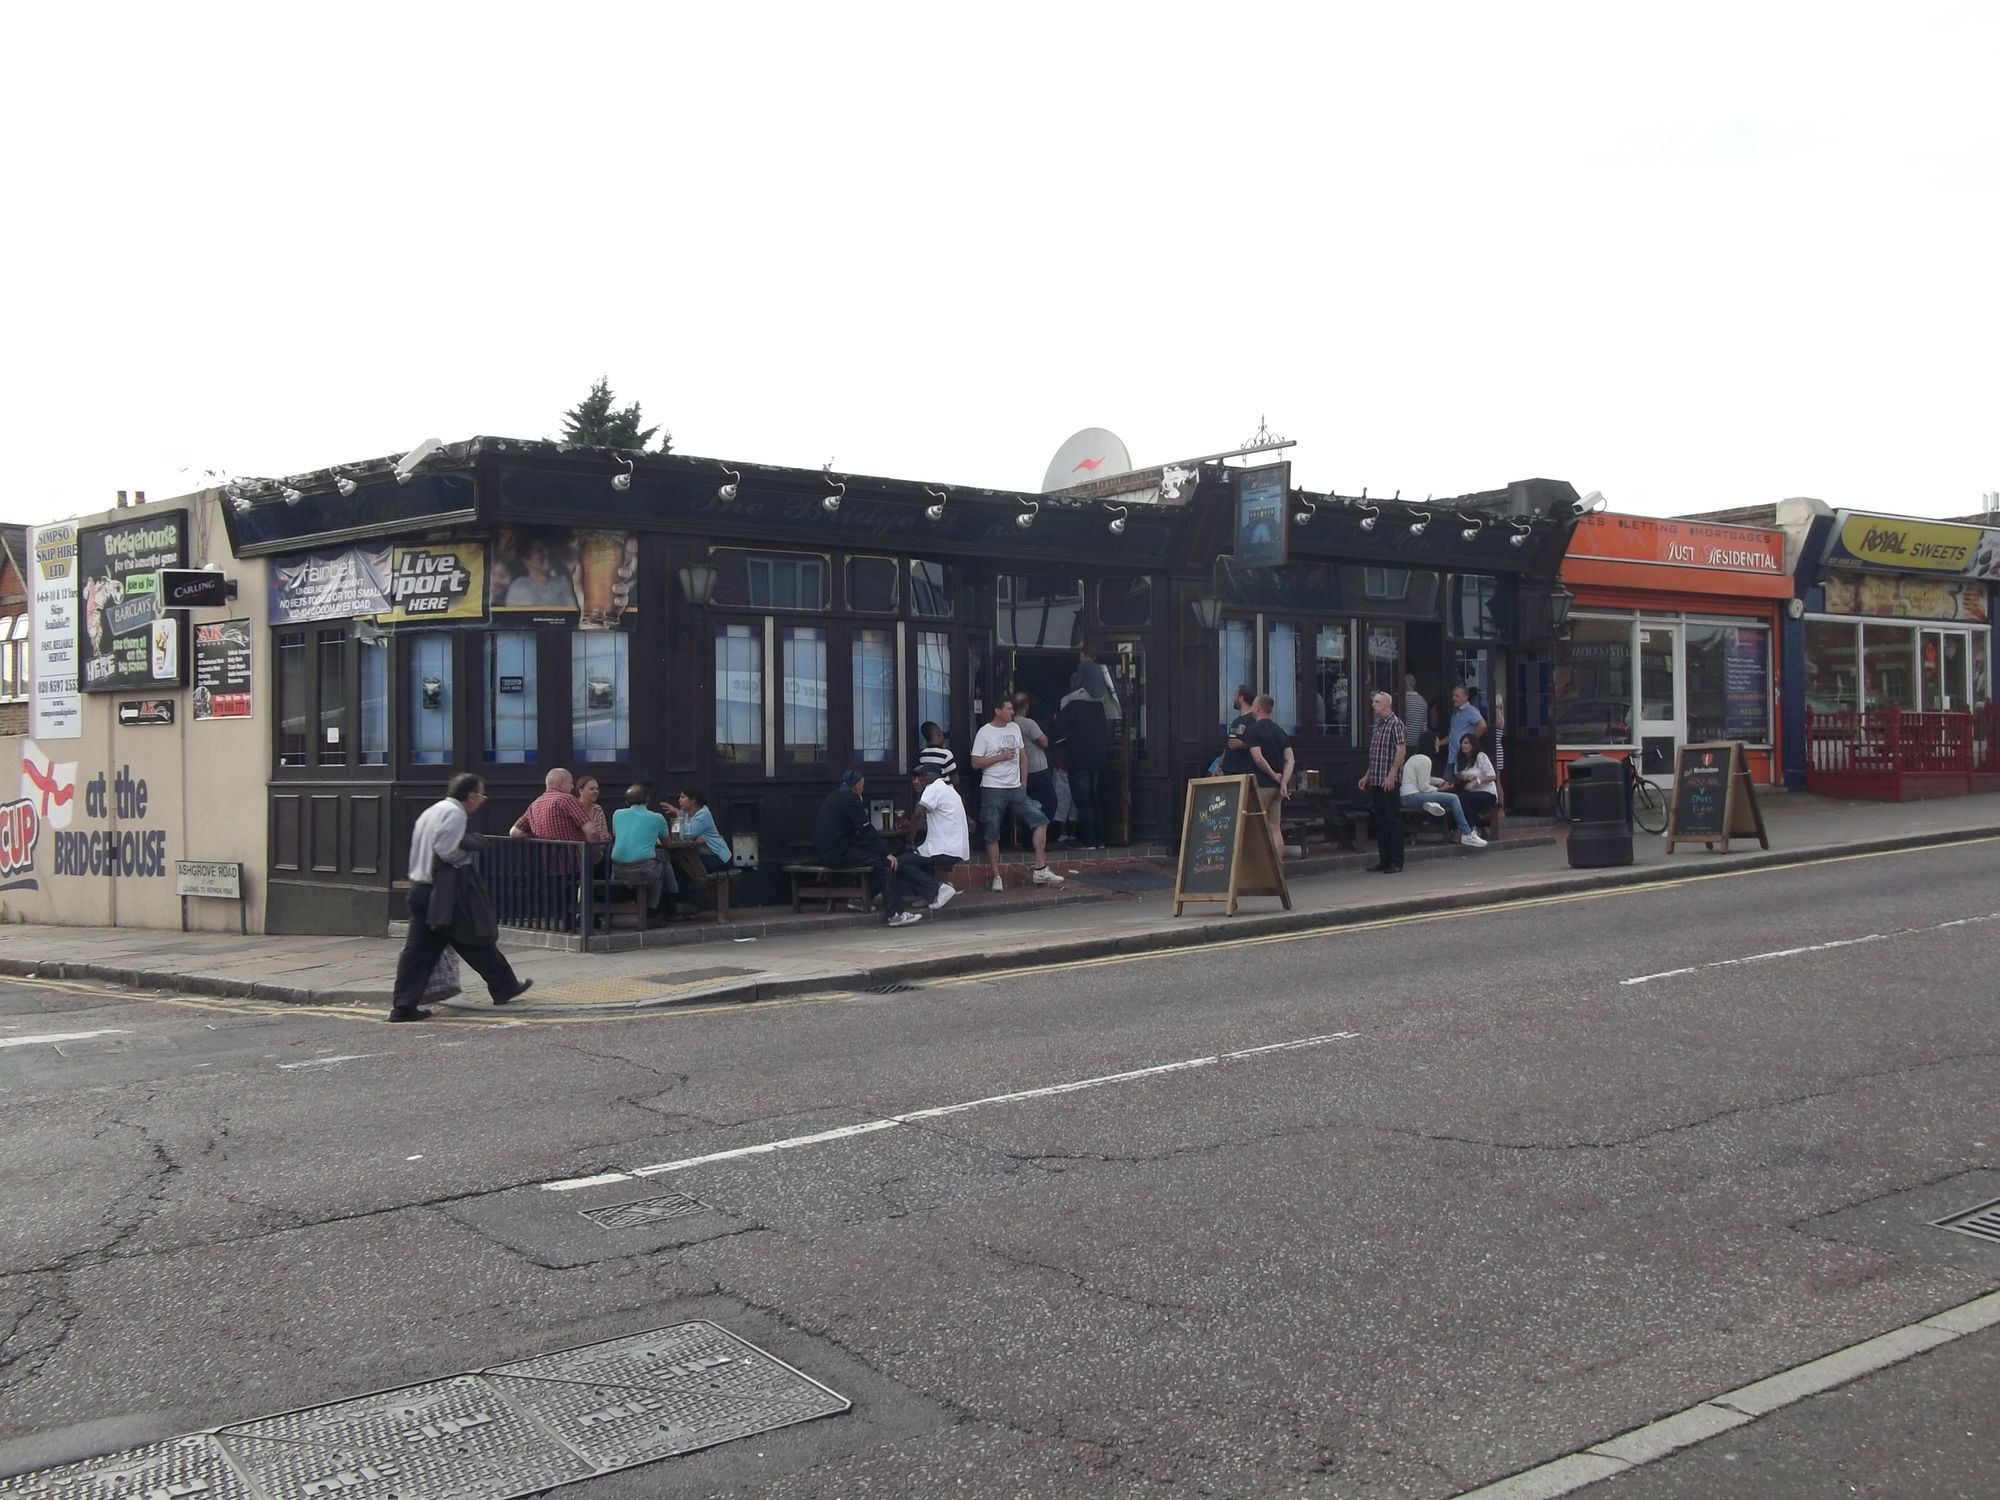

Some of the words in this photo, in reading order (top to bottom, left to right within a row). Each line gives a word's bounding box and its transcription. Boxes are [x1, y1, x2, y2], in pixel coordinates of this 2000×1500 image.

[38, 526, 76, 545] SIMPSON
[104, 525, 177, 557] Bridgehouse
[1623, 520, 1679, 534] LETTING
[1695, 528, 1772, 544] MORTGAGES
[36, 547, 56, 563] SKIP
[57, 543, 78, 560] HIRE
[1666, 541, 1696, 562] JUST
[1704, 544, 1777, 569] RESIDENTIAL
[1860, 527, 1908, 554] ROYAL
[1910, 543, 1967, 561] SWEETS
[49, 564, 65, 578] LTD
[401, 553, 455, 575] Live
[174, 580, 215, 598] CARLING
[357, 588, 382, 598] SMALL
[392, 571, 465, 602] port
[114, 598, 151, 622] BARCLAYS
[408, 597, 448, 612] HERE
[196, 623, 225, 643] AK
[86, 654, 115, 681] HERE
[38, 681, 48, 694] 020
[140, 700, 157, 714] AK
[86, 771, 107, 819] at
[115, 764, 148, 820] the
[0, 800, 38, 873] CUP
[54, 830, 166, 877] BRIDGEHOUSE
[178, 864, 216, 877] ASHGROVE
[218, 866, 237, 878] ROAD
